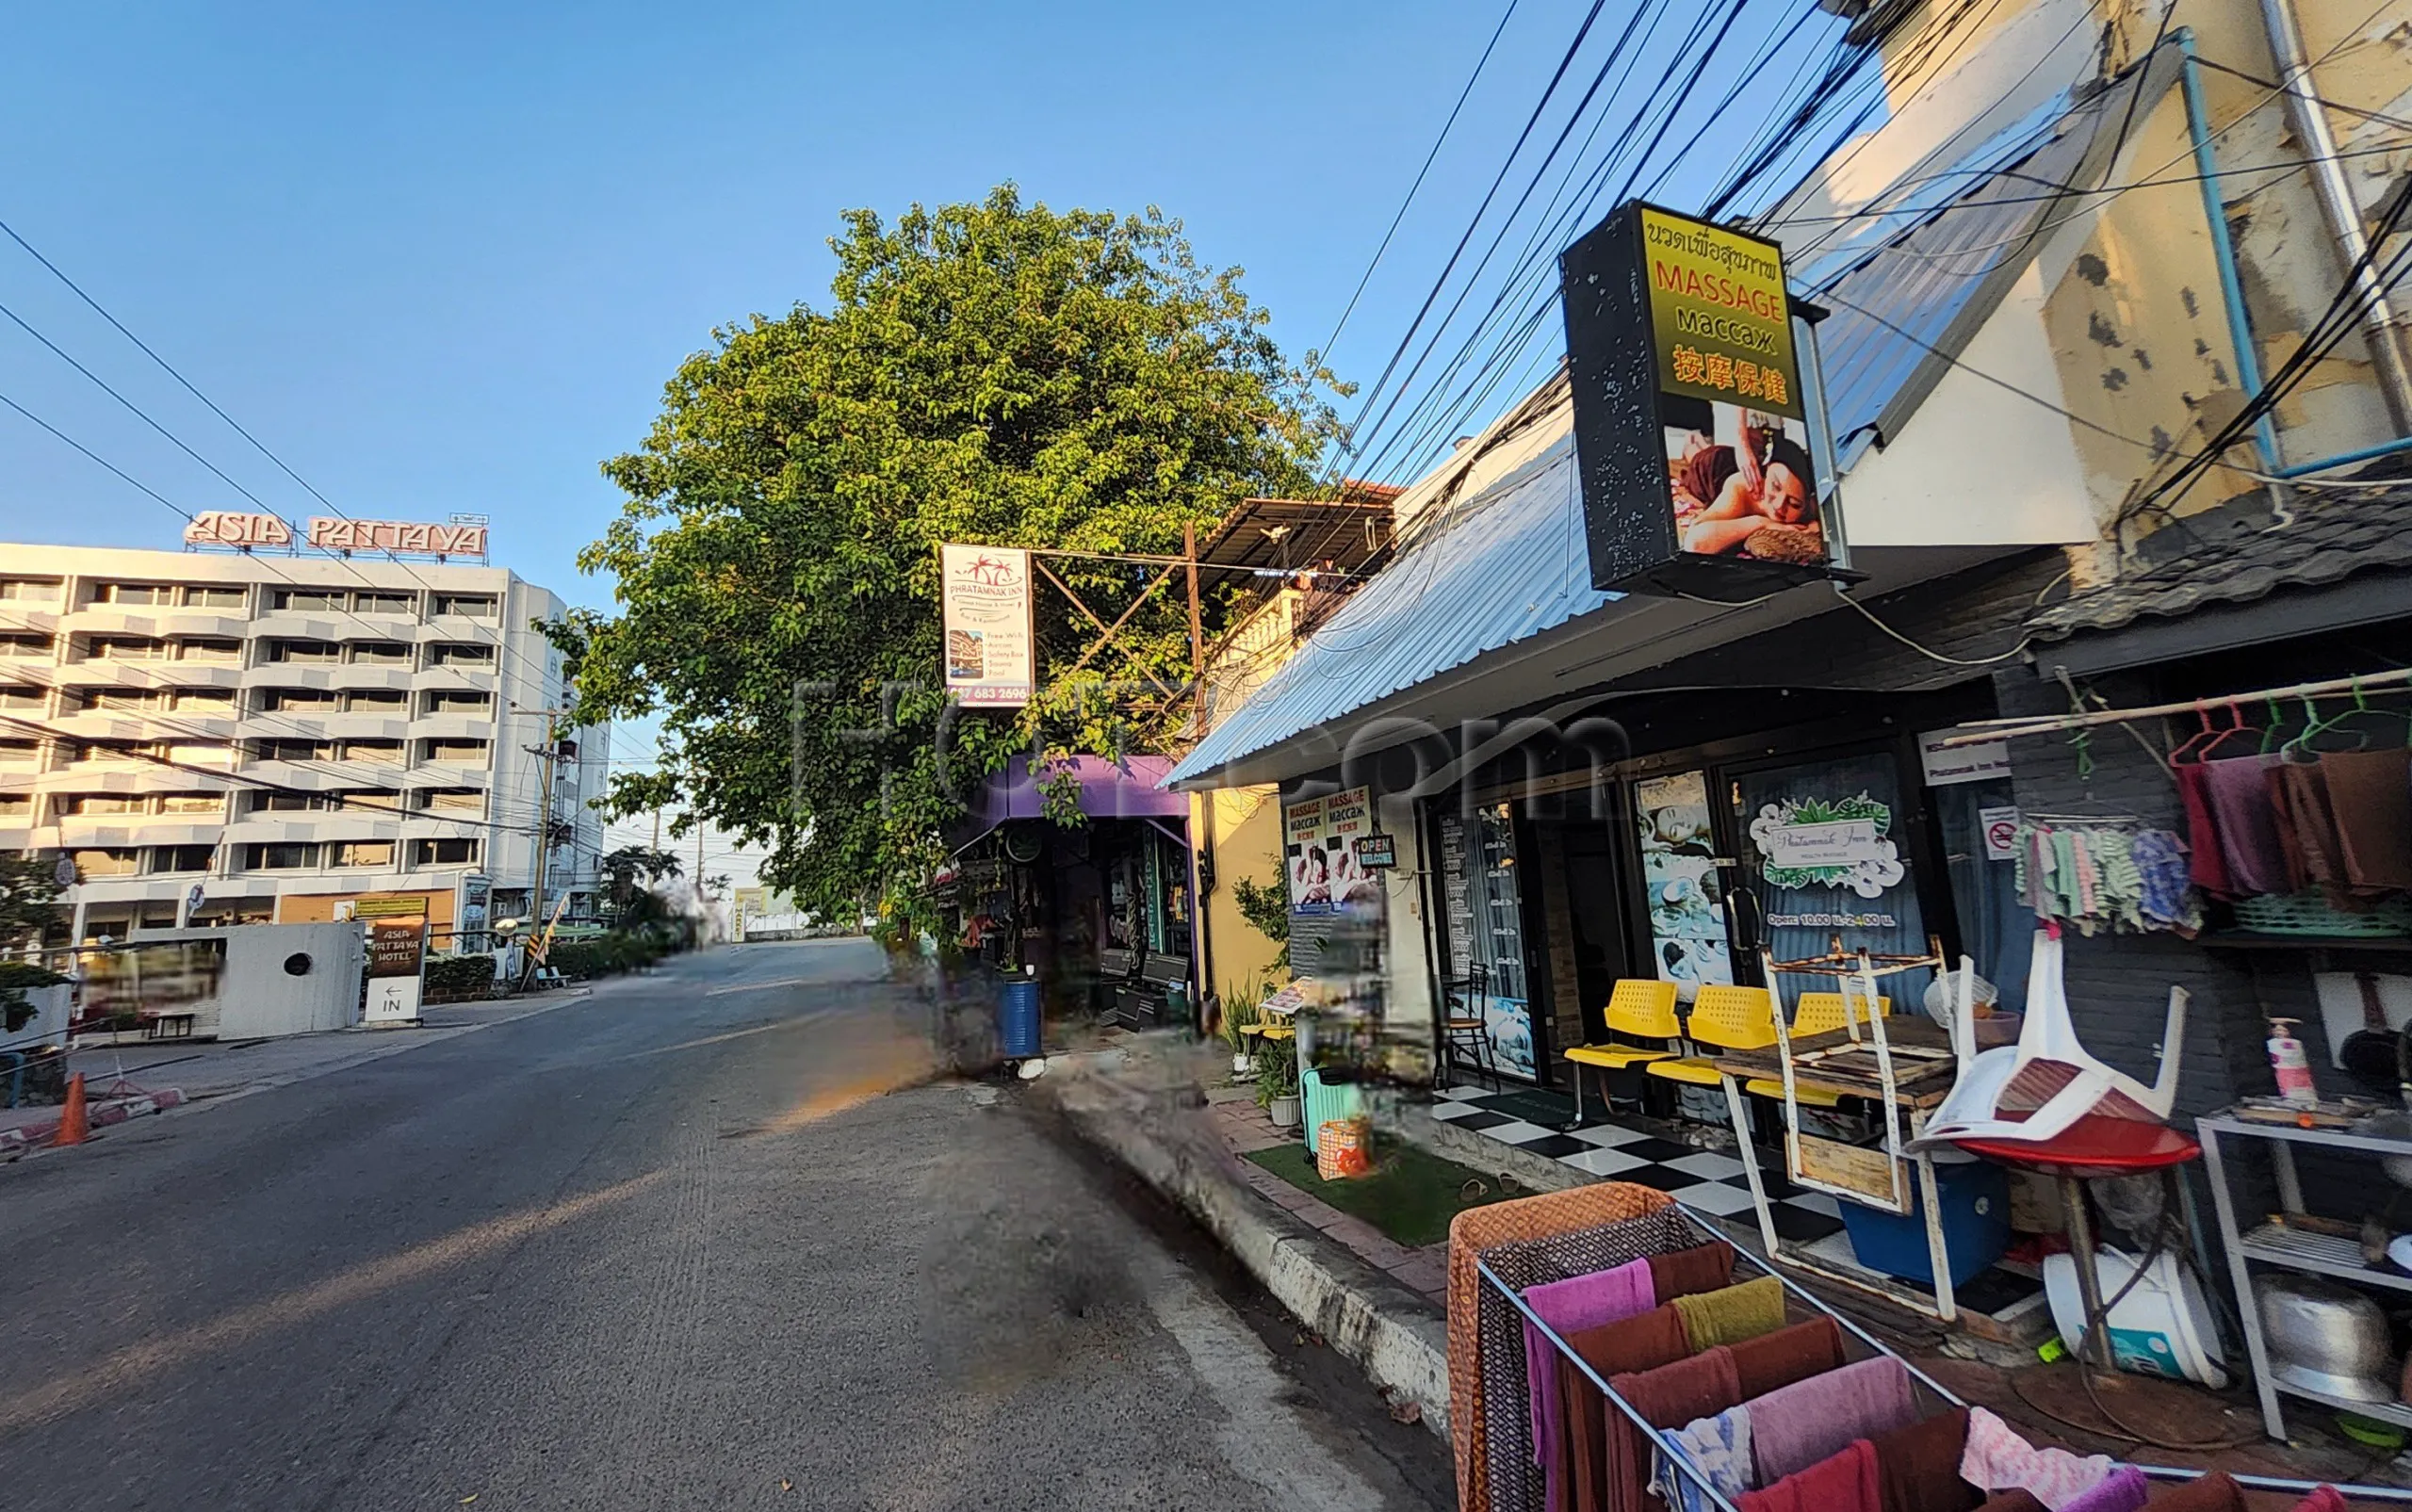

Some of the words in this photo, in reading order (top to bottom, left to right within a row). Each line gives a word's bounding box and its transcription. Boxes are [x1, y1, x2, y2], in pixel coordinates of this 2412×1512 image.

[1655, 260, 1784, 323] MASSAGE
[1672, 344, 1788, 404] 按摩保健
[187, 512, 291, 545] ASIA
[309, 518, 487, 556] PATTAYA
[974, 687, 996, 699] 683
[998, 688, 1027, 699] 2696
[1328, 789, 1365, 810] MASSAGE
[1289, 801, 1321, 820] MASSAGE
[1361, 838, 1390, 853] OPEN
[1361, 853, 1393, 865] WELCOME
[383, 930, 411, 939] ASIA
[378, 952, 412, 962] HOTEL
[383, 1000, 400, 1013] IN
